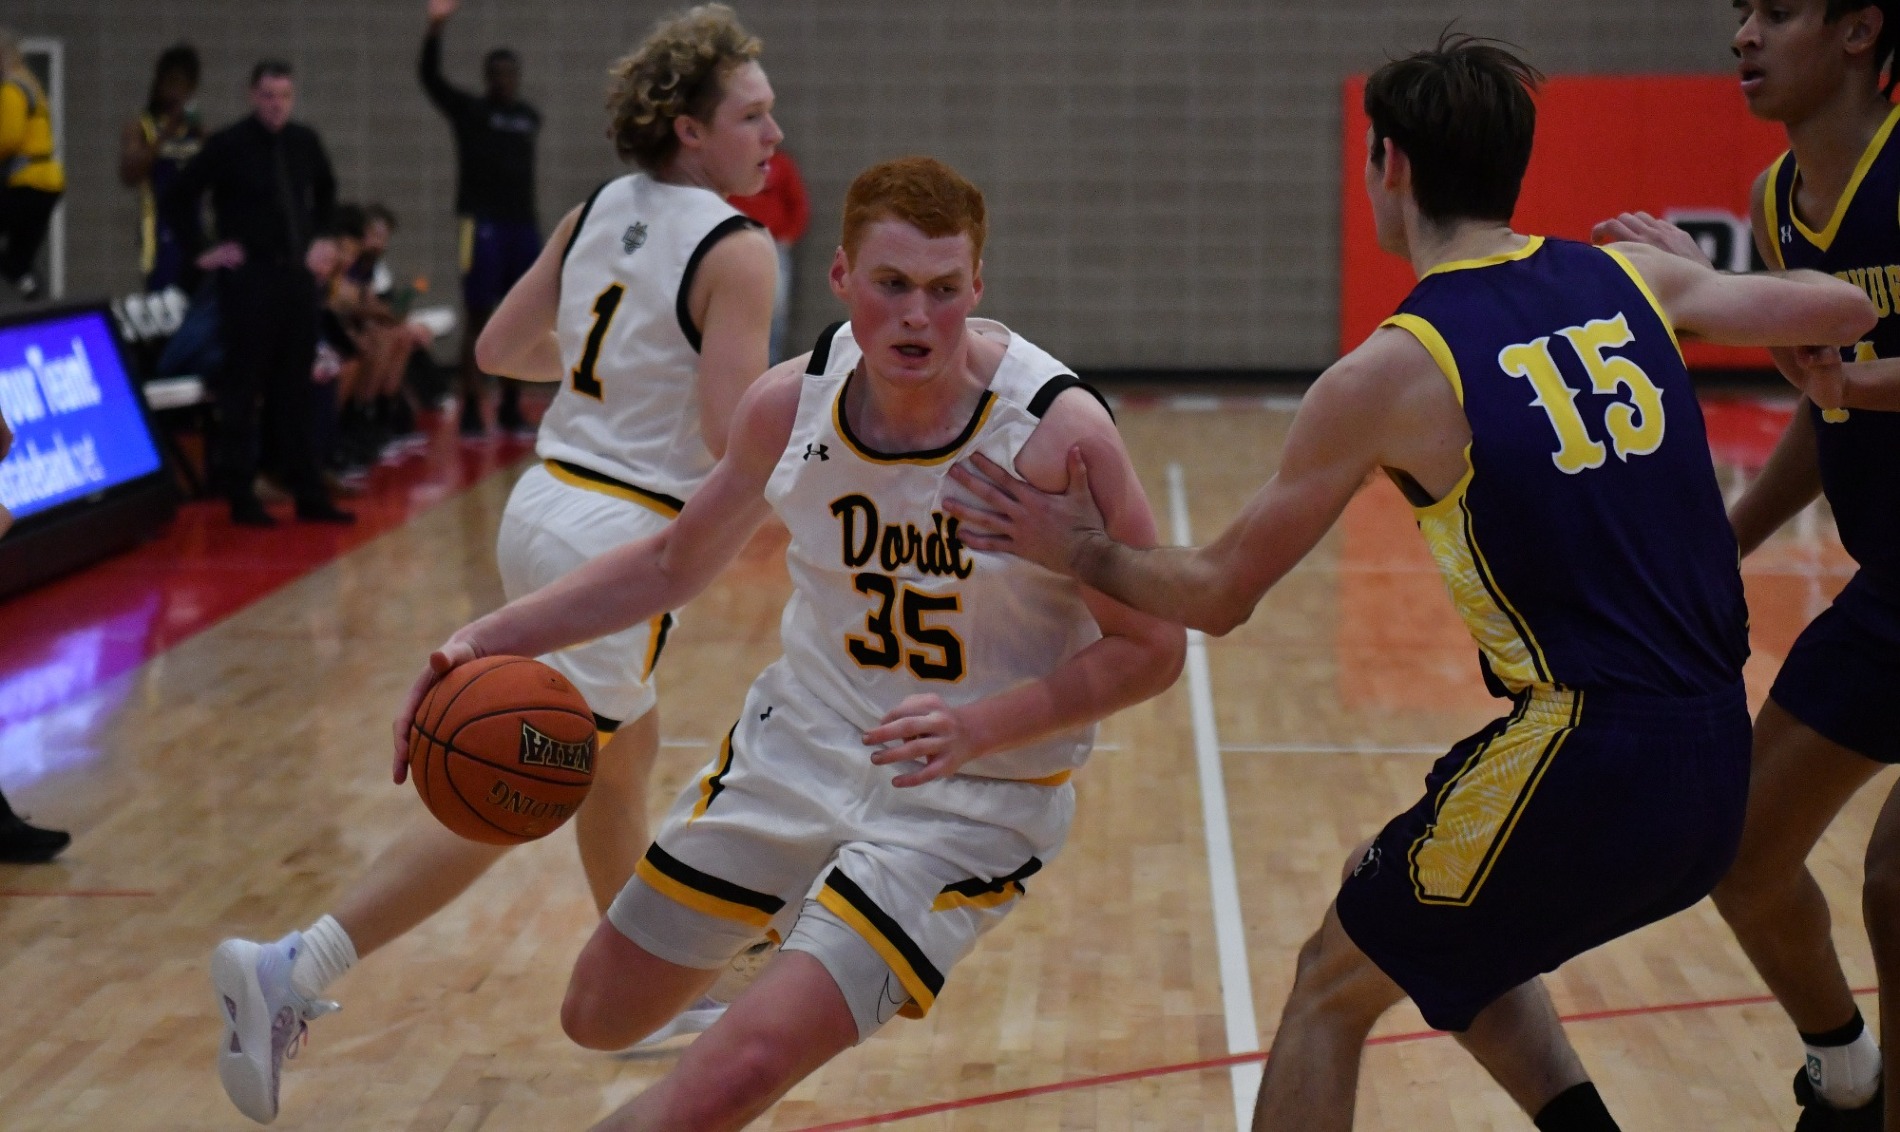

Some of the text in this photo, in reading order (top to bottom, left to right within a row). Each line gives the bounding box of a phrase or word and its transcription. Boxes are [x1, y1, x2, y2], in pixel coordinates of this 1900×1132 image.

[571, 282, 627, 404] 1
[1498, 311, 1666, 475] 15
[829, 493, 975, 580] Dordt
[844, 570, 968, 684] 35
[522, 722, 595, 774] NAIA
